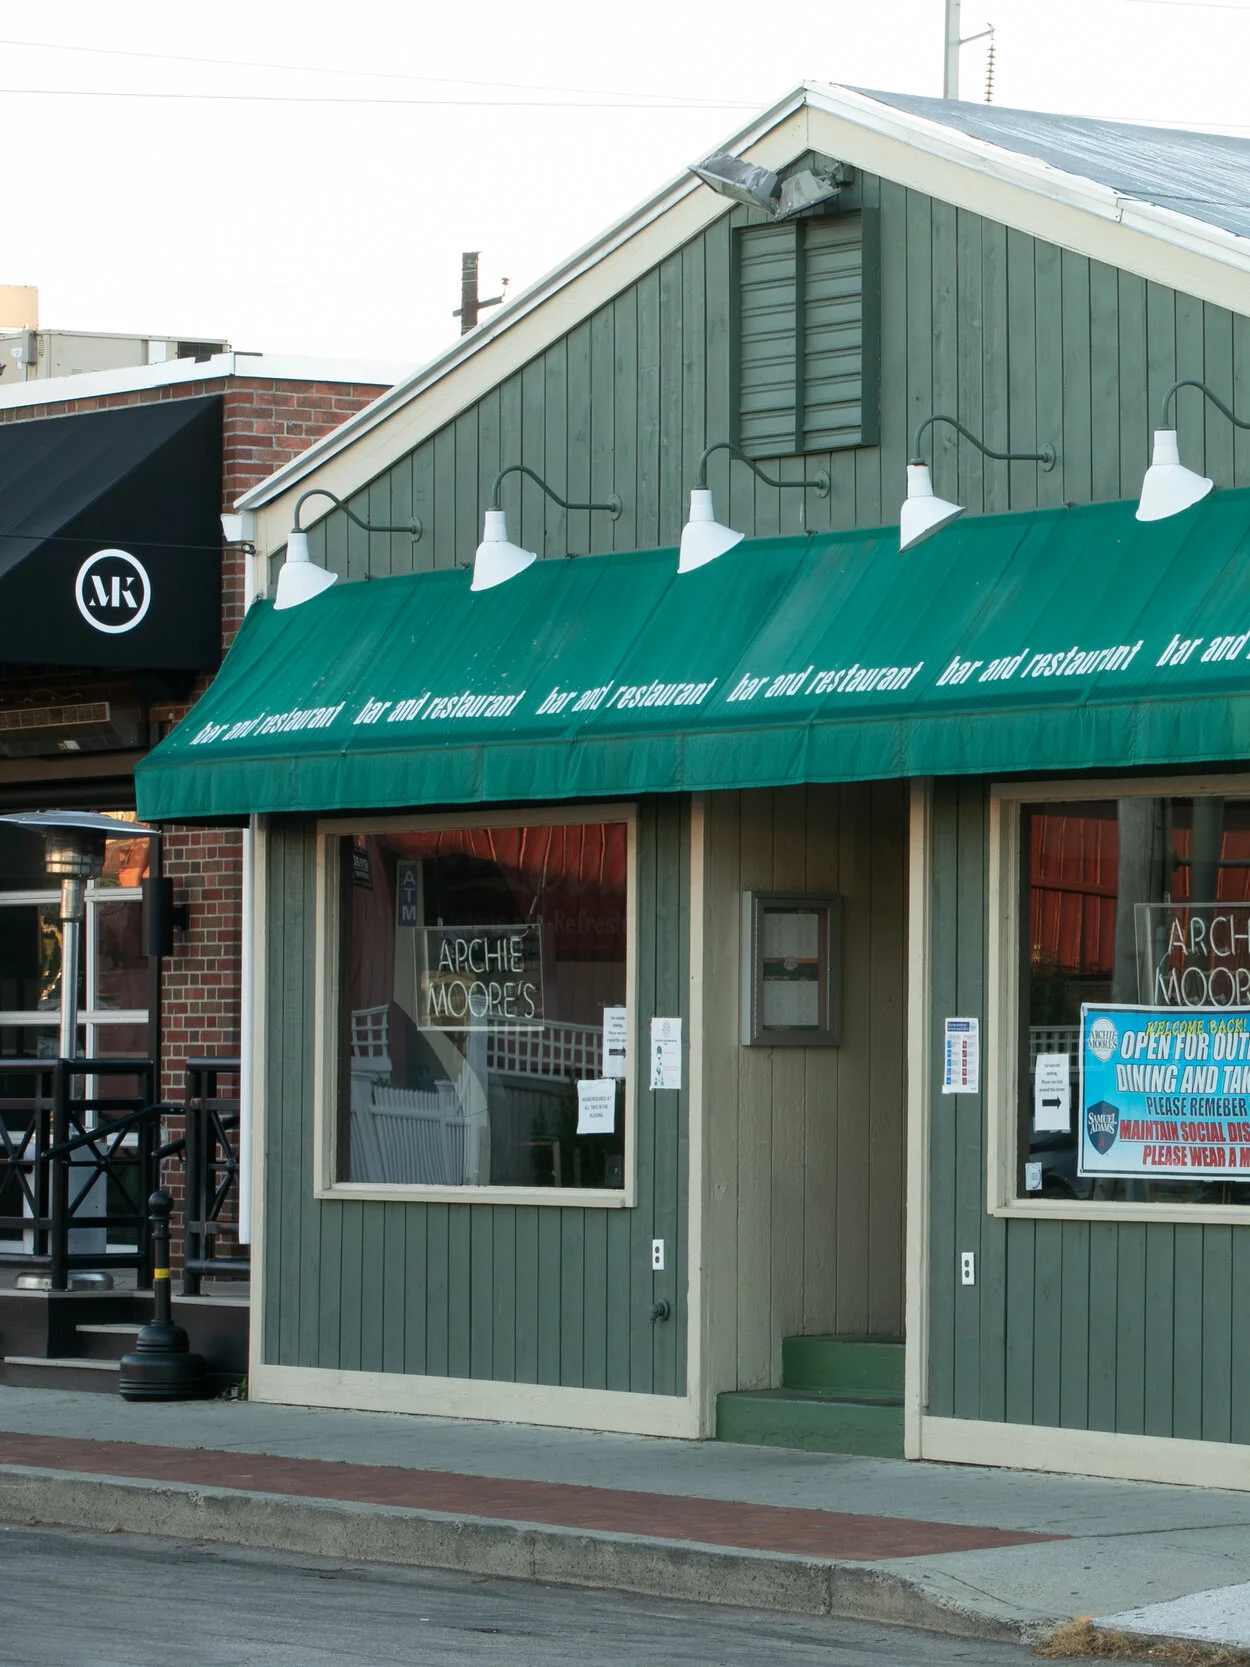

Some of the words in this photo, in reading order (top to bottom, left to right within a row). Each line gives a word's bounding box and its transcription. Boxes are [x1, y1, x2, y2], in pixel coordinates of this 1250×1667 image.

[89, 575, 138, 609] MK
[936, 656, 982, 686] bar
[978, 649, 1029, 683] and
[1022, 640, 1144, 678] restaurant
[1156, 634, 1202, 667] bar
[536, 688, 576, 715] bar
[572, 681, 614, 712] and
[606, 678, 718, 709] restaurant
[727, 673, 769, 702] bar
[764, 666, 814, 697] and
[805, 662, 924, 695] restaurant
[190, 722, 228, 745] bar
[223, 713, 265, 741] and
[254, 702, 346, 736] restaurant
[354, 697, 393, 725] bar
[387, 692, 431, 722] and
[422, 690, 526, 720] restaurant
[402, 869, 416, 921] ATM
[439, 936, 524, 974] ARCHIE
[427, 981, 536, 1018] MOORE'S
[1090, 1031, 1117, 1039] ARCHIE
[1146, 1021, 1204, 1035] WELCOME
[1210, 1019, 1246, 1034] BACK!
[1121, 1031, 1175, 1060] OPEN
[1174, 1034, 1210, 1061] FOR
[1116, 1064, 1178, 1093] DINING
[1180, 1065, 1219, 1094] AND
[1088, 1113, 1117, 1125] SAMUEL
[1146, 1097, 1186, 1116] PLEASE
[1190, 1097, 1248, 1116] REMEBER
[1090, 1123, 1115, 1134] ADAMS
[1119, 1120, 1178, 1141] MAINTAIN
[1181, 1121, 1226, 1142] SOCIAL
[1143, 1145, 1186, 1166] PLEASE
[1190, 1146, 1226, 1167] WEAR
[1228, 1148, 1236, 1167] A
